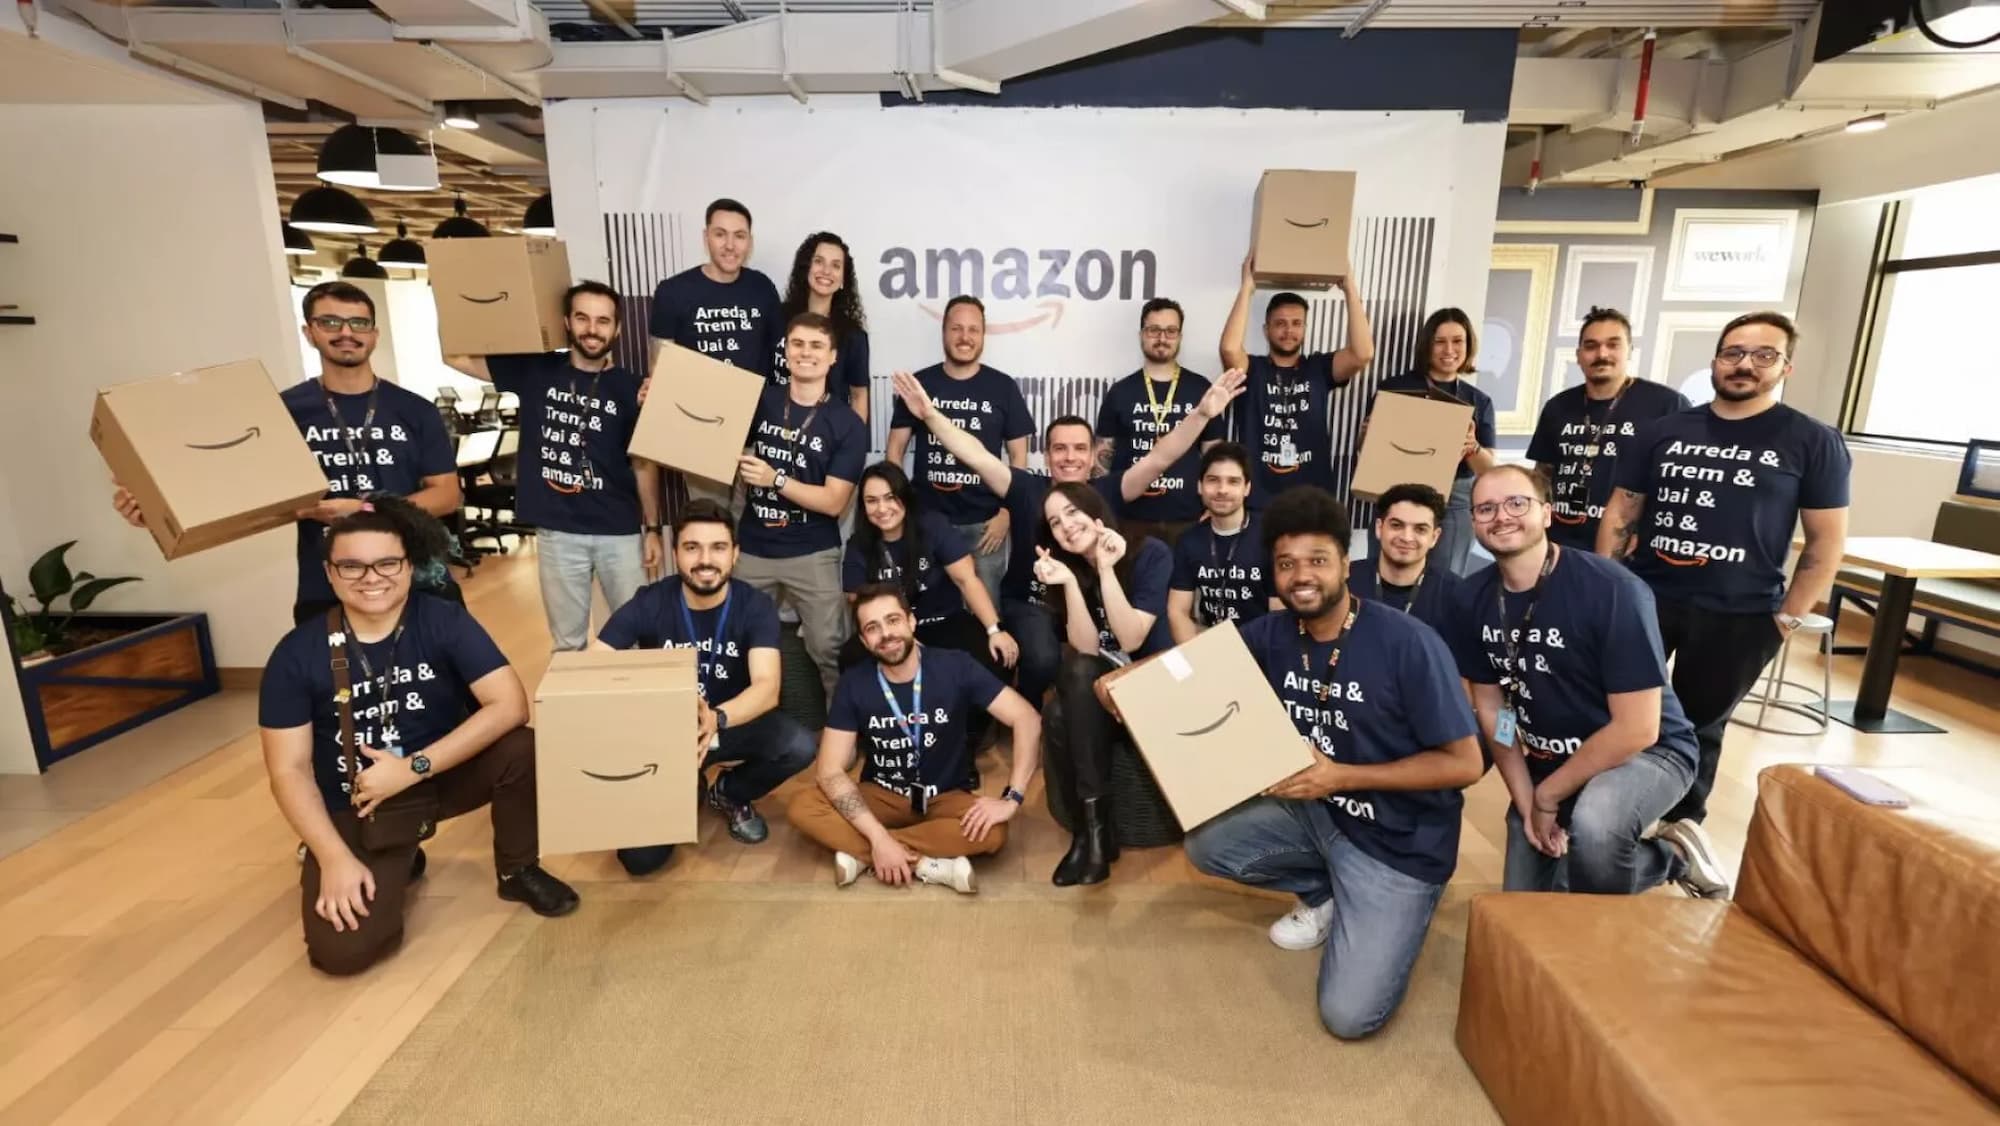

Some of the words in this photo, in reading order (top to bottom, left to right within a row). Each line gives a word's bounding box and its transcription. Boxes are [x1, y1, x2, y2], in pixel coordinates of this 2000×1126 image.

[879, 246, 1157, 300] amazon
[696, 306, 748, 320] Arreda
[694, 321, 736, 333] Trem
[740, 319, 753, 331] &
[697, 338, 723, 353] Uai
[726, 338, 740, 351] &
[604, 400, 618, 416] &
[932, 397, 978, 411] Arreda
[981, 400, 993, 414] &
[588, 416, 603, 432] &
[970, 417, 982, 430] &
[1620, 422, 1635, 436] &
[390, 425, 408, 442] &
[569, 432, 581, 447] &
[809, 436, 823, 452] &
[1603, 441, 1617, 456] &
[376, 448, 395, 465] &
[559, 451, 573, 466] &
[795, 453, 807, 469] &
[928, 452, 942, 464] Sô
[945, 453, 957, 465] &
[1665, 441, 1752, 461] Arreda
[1759, 450, 1780, 468] &
[928, 470, 981, 485] amazon
[1659, 462, 1725, 483] Trem
[1732, 469, 1756, 487] &
[329, 474, 350, 492] ai
[356, 474, 375, 491] &
[1657, 487, 1690, 504] Uai
[1695, 490, 1716, 508] &
[1655, 511, 1674, 527] Sô
[1679, 515, 1699, 532] &
[1650, 535, 1746, 563] amazon
[1250, 567, 1261, 580] &
[1241, 586, 1253, 600] &
[1227, 606, 1240, 619] &
[1546, 627, 1565, 648] &
[725, 641, 739, 657] &
[417, 662, 436, 681] &
[715, 663, 728, 679] &
[1535, 654, 1551, 674] &
[1346, 681, 1364, 703] &
[405, 691, 426, 711] &
[934, 707, 949, 724] &
[1335, 709, 1349, 731] &
[924, 732, 937, 748] &
[1321, 735, 1335, 756] &
[873, 753, 902, 767] Uai
